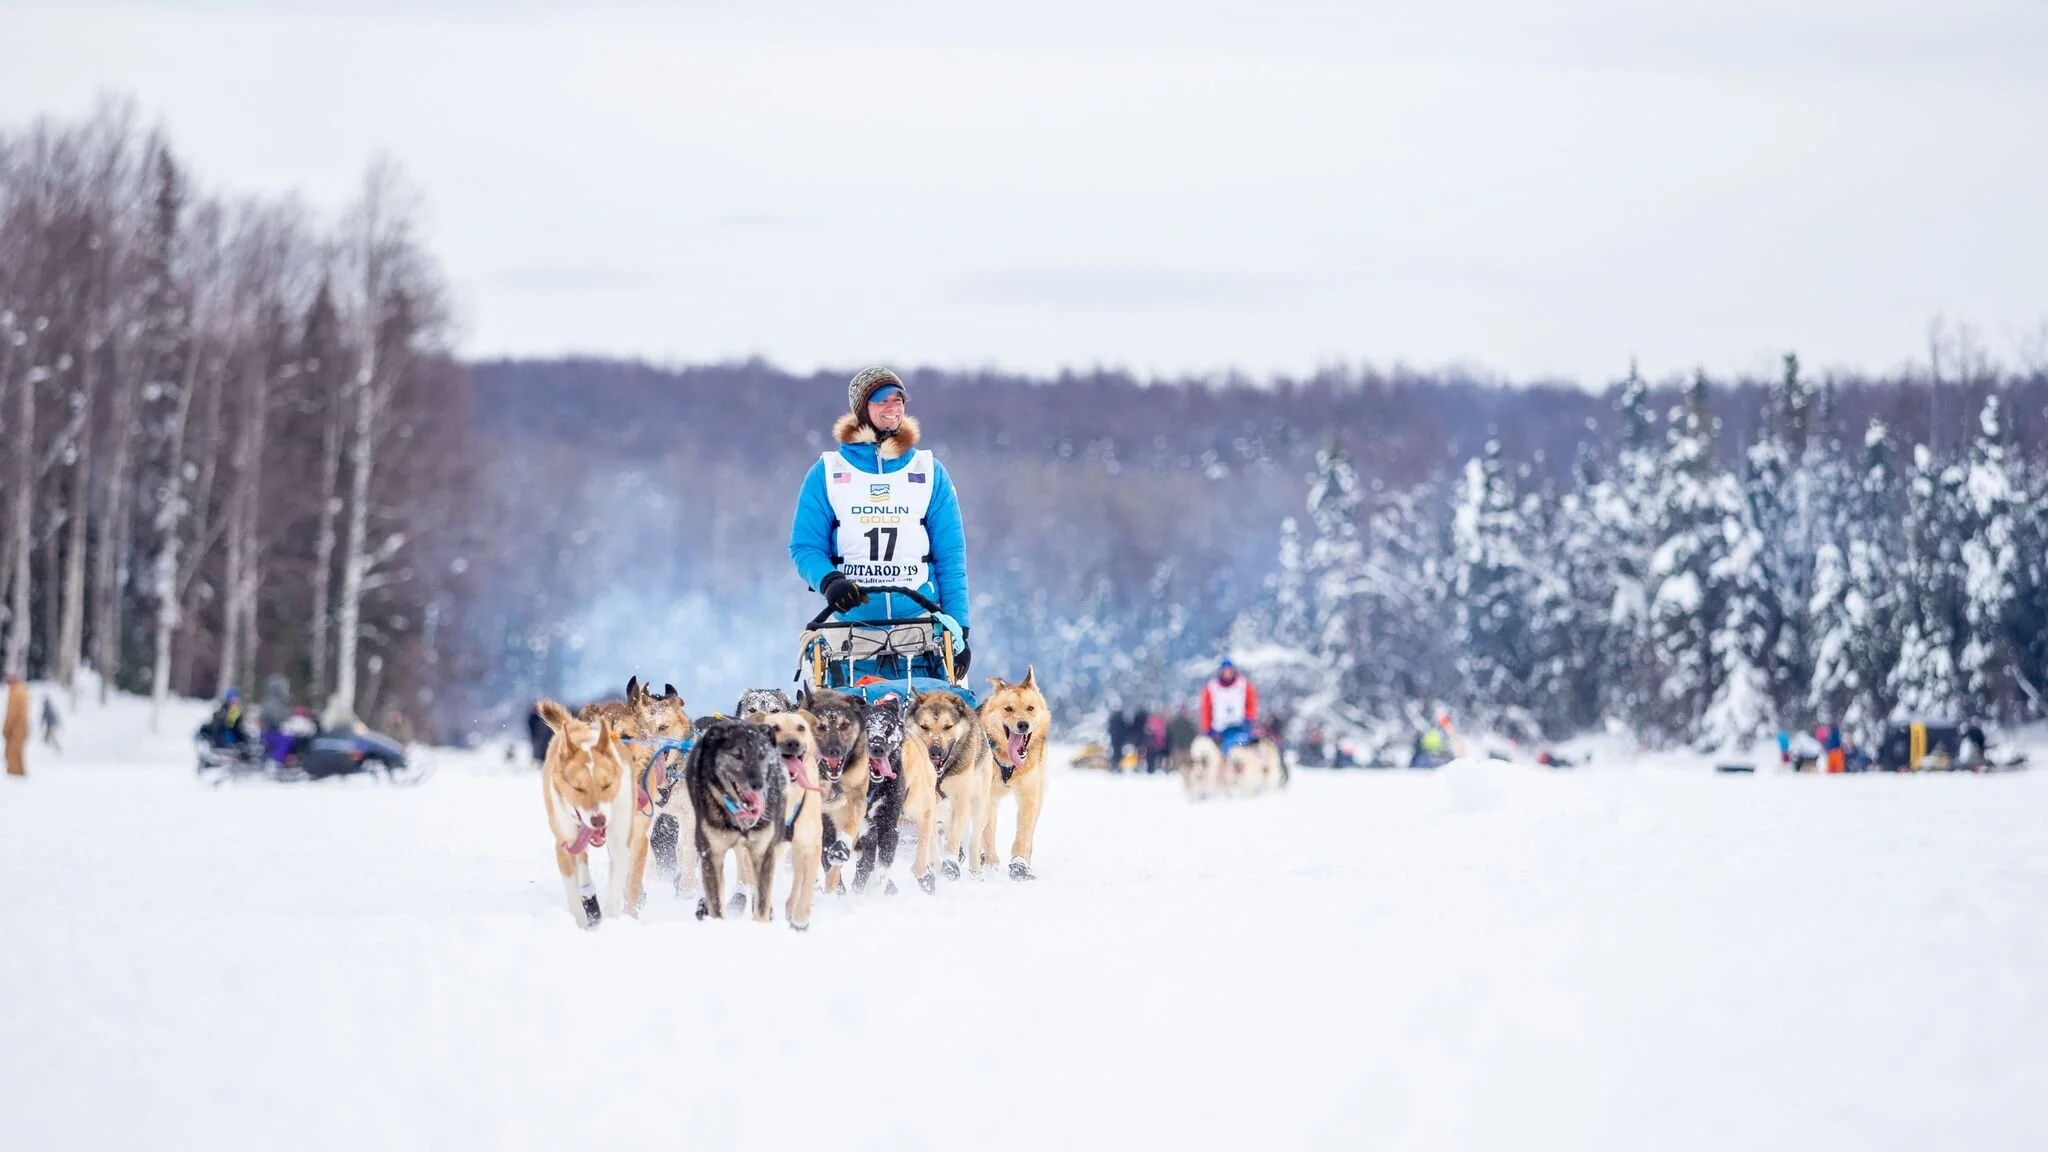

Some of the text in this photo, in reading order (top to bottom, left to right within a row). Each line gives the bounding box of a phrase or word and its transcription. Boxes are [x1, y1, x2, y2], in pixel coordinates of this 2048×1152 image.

[851, 506, 909, 514] DONLIN
[859, 516, 901, 524] GOLD
[864, 527, 898, 562] 17
[844, 564, 901, 576] IDITAROD
